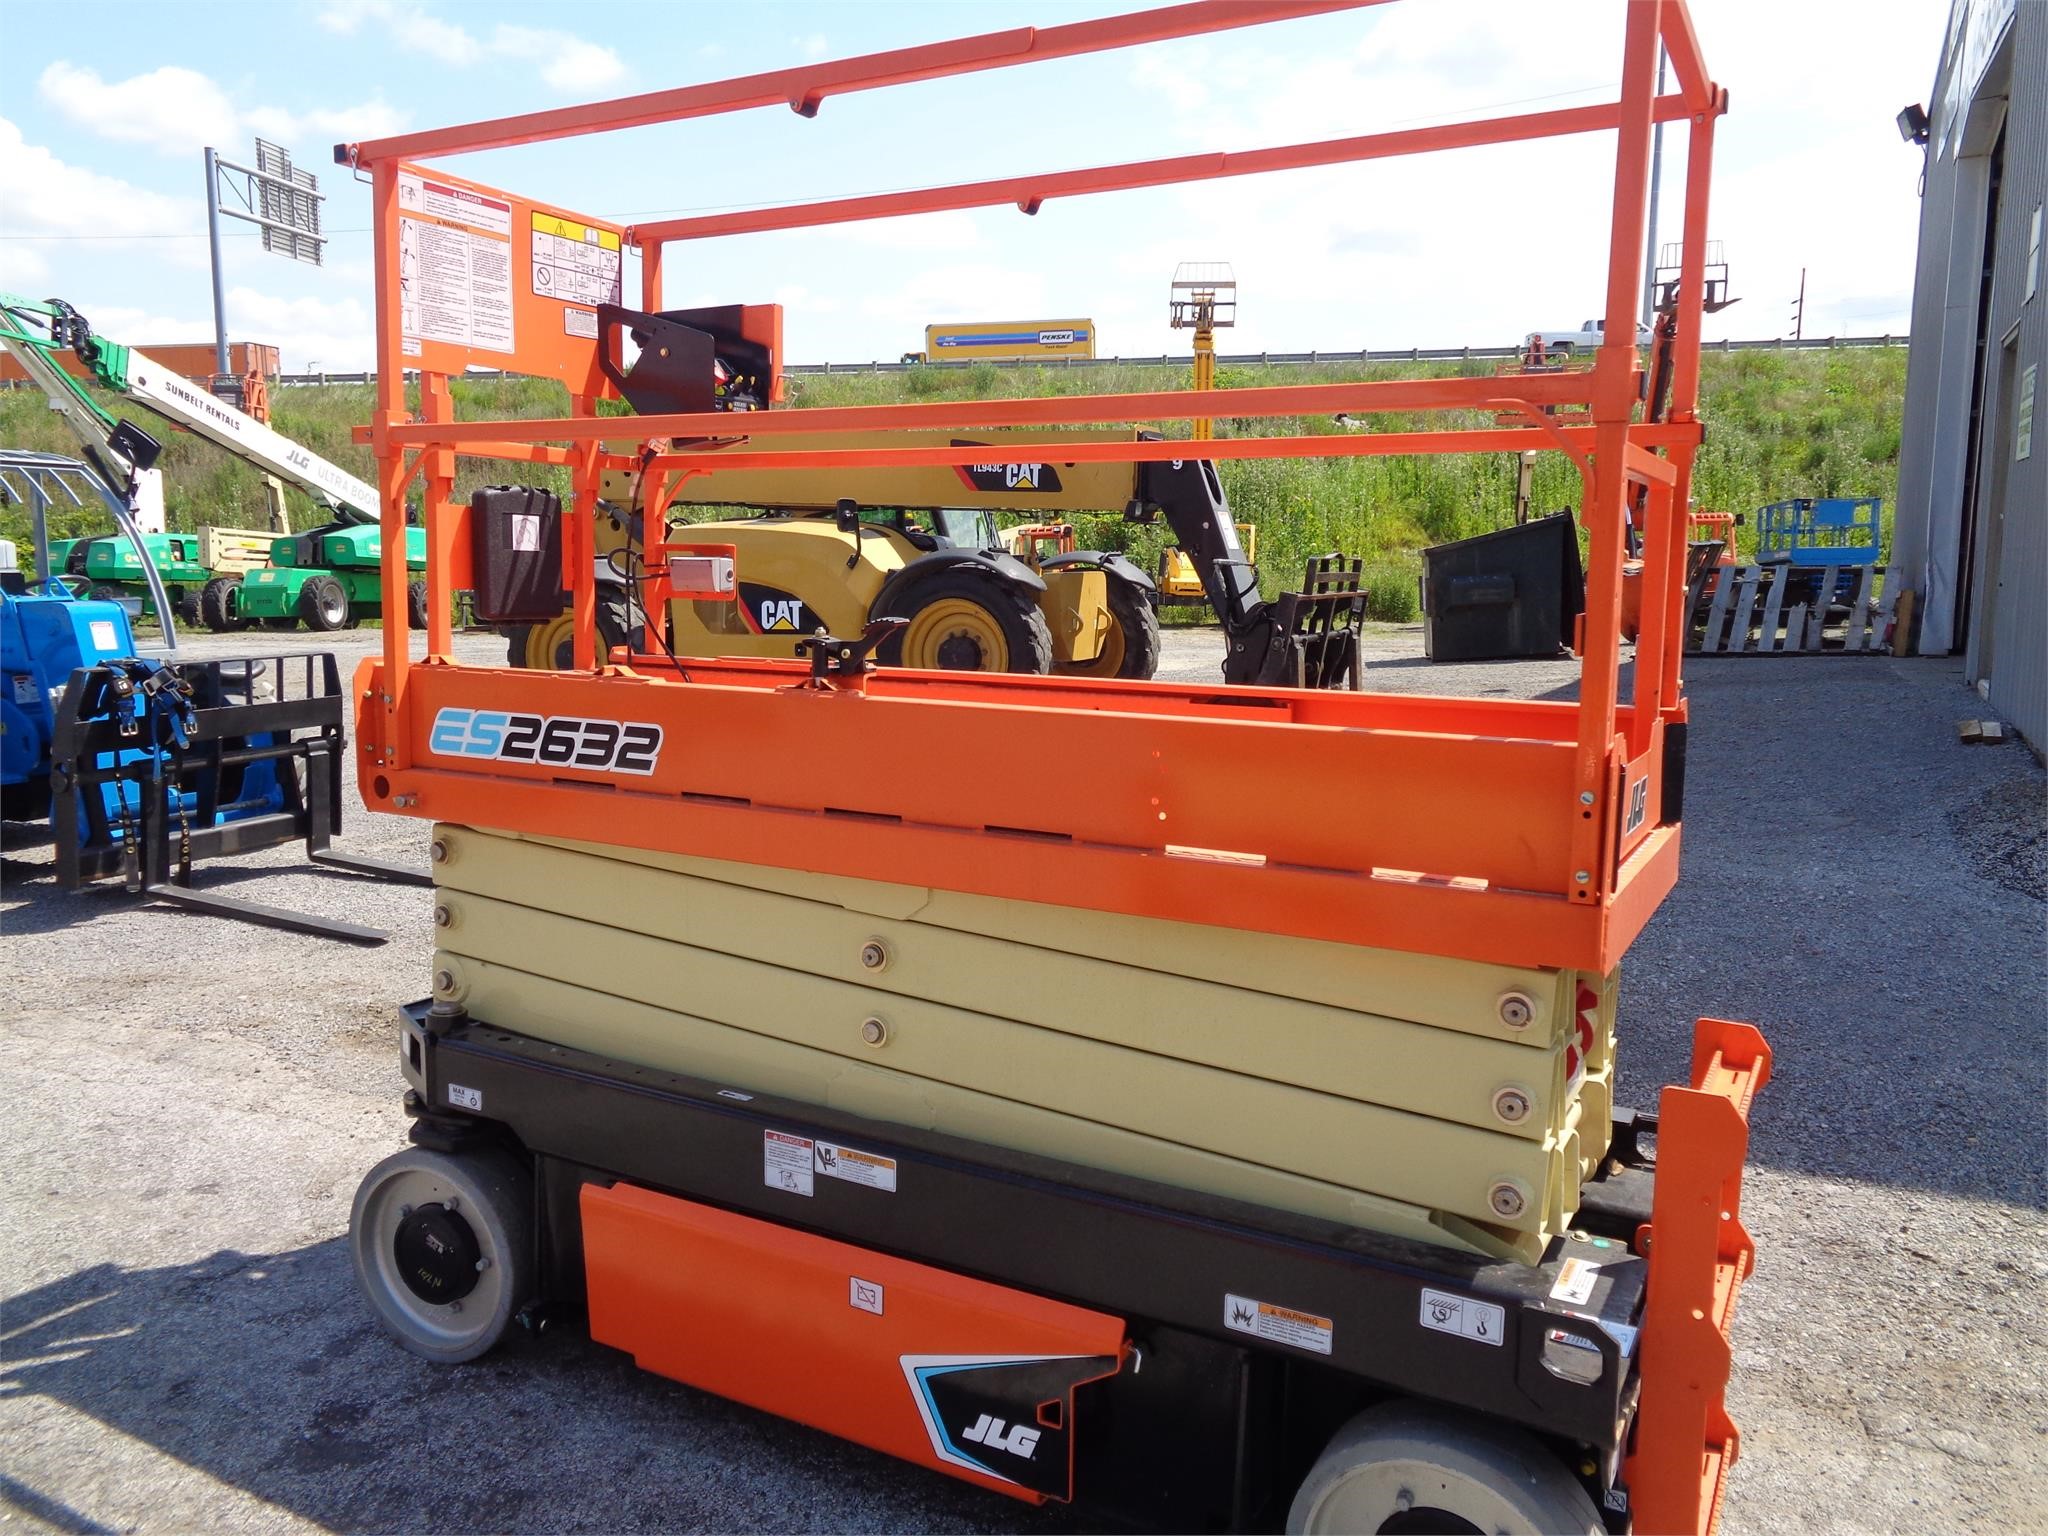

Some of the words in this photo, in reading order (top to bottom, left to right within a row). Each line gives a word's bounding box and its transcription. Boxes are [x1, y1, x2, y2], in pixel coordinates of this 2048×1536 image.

[442, 221, 469, 233] WARNING
[1041, 333, 1072, 341] PENSKE
[165, 381, 204, 409] SUNBELT
[206, 404, 241, 431] RENTALS
[286, 450, 310, 470] JLG
[318, 465, 349, 493] ULTRA
[1006, 463, 1042, 488] CAT
[761, 600, 803, 630] CAT
[430, 708, 663, 775] ES2632
[1626, 775, 1648, 836] JLG
[779, 1135, 806, 1147] DANGER
[1280, 1310, 1319, 1326] WARNING
[962, 1413, 1042, 1460] JLG
